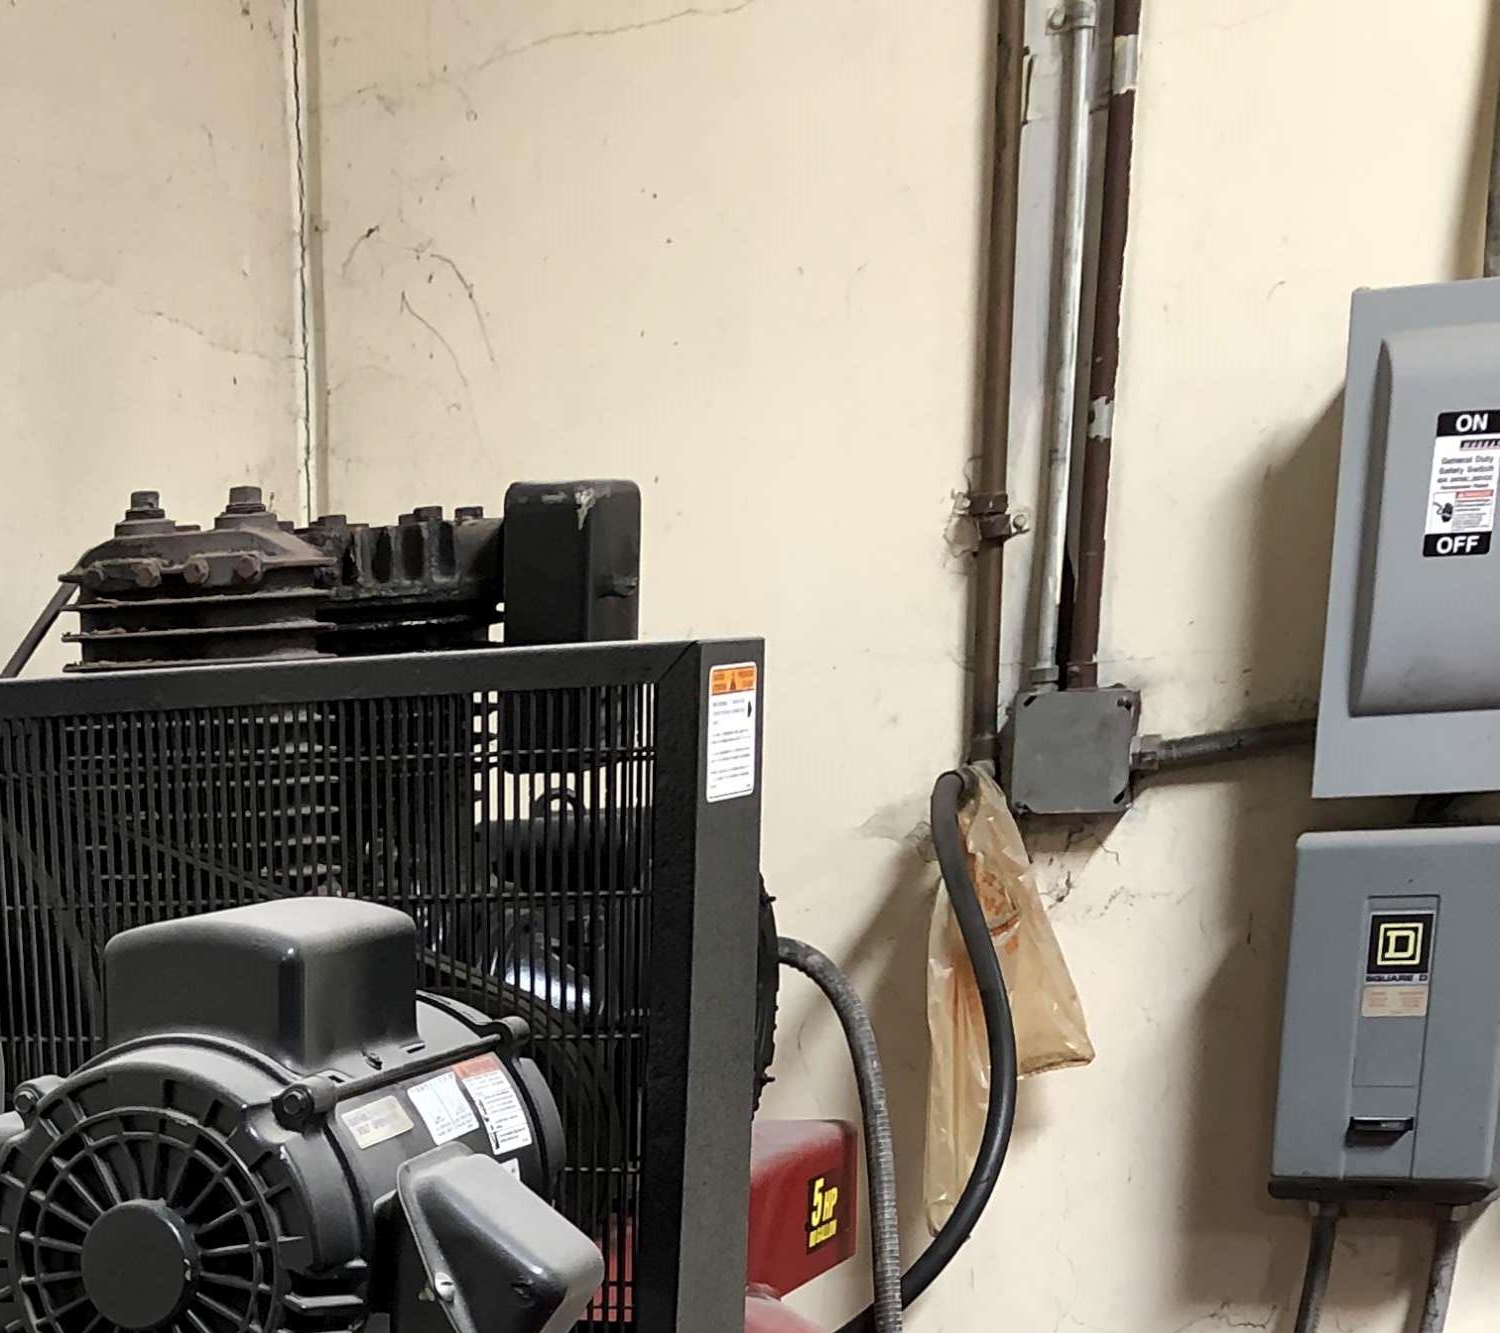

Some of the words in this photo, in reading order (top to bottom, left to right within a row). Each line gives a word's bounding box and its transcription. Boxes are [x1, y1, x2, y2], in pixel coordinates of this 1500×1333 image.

[1456, 413, 1488, 432] ON
[1436, 535, 1480, 554] OFF
[1385, 930, 1415, 958] D
[811, 1177, 825, 1227] 5
